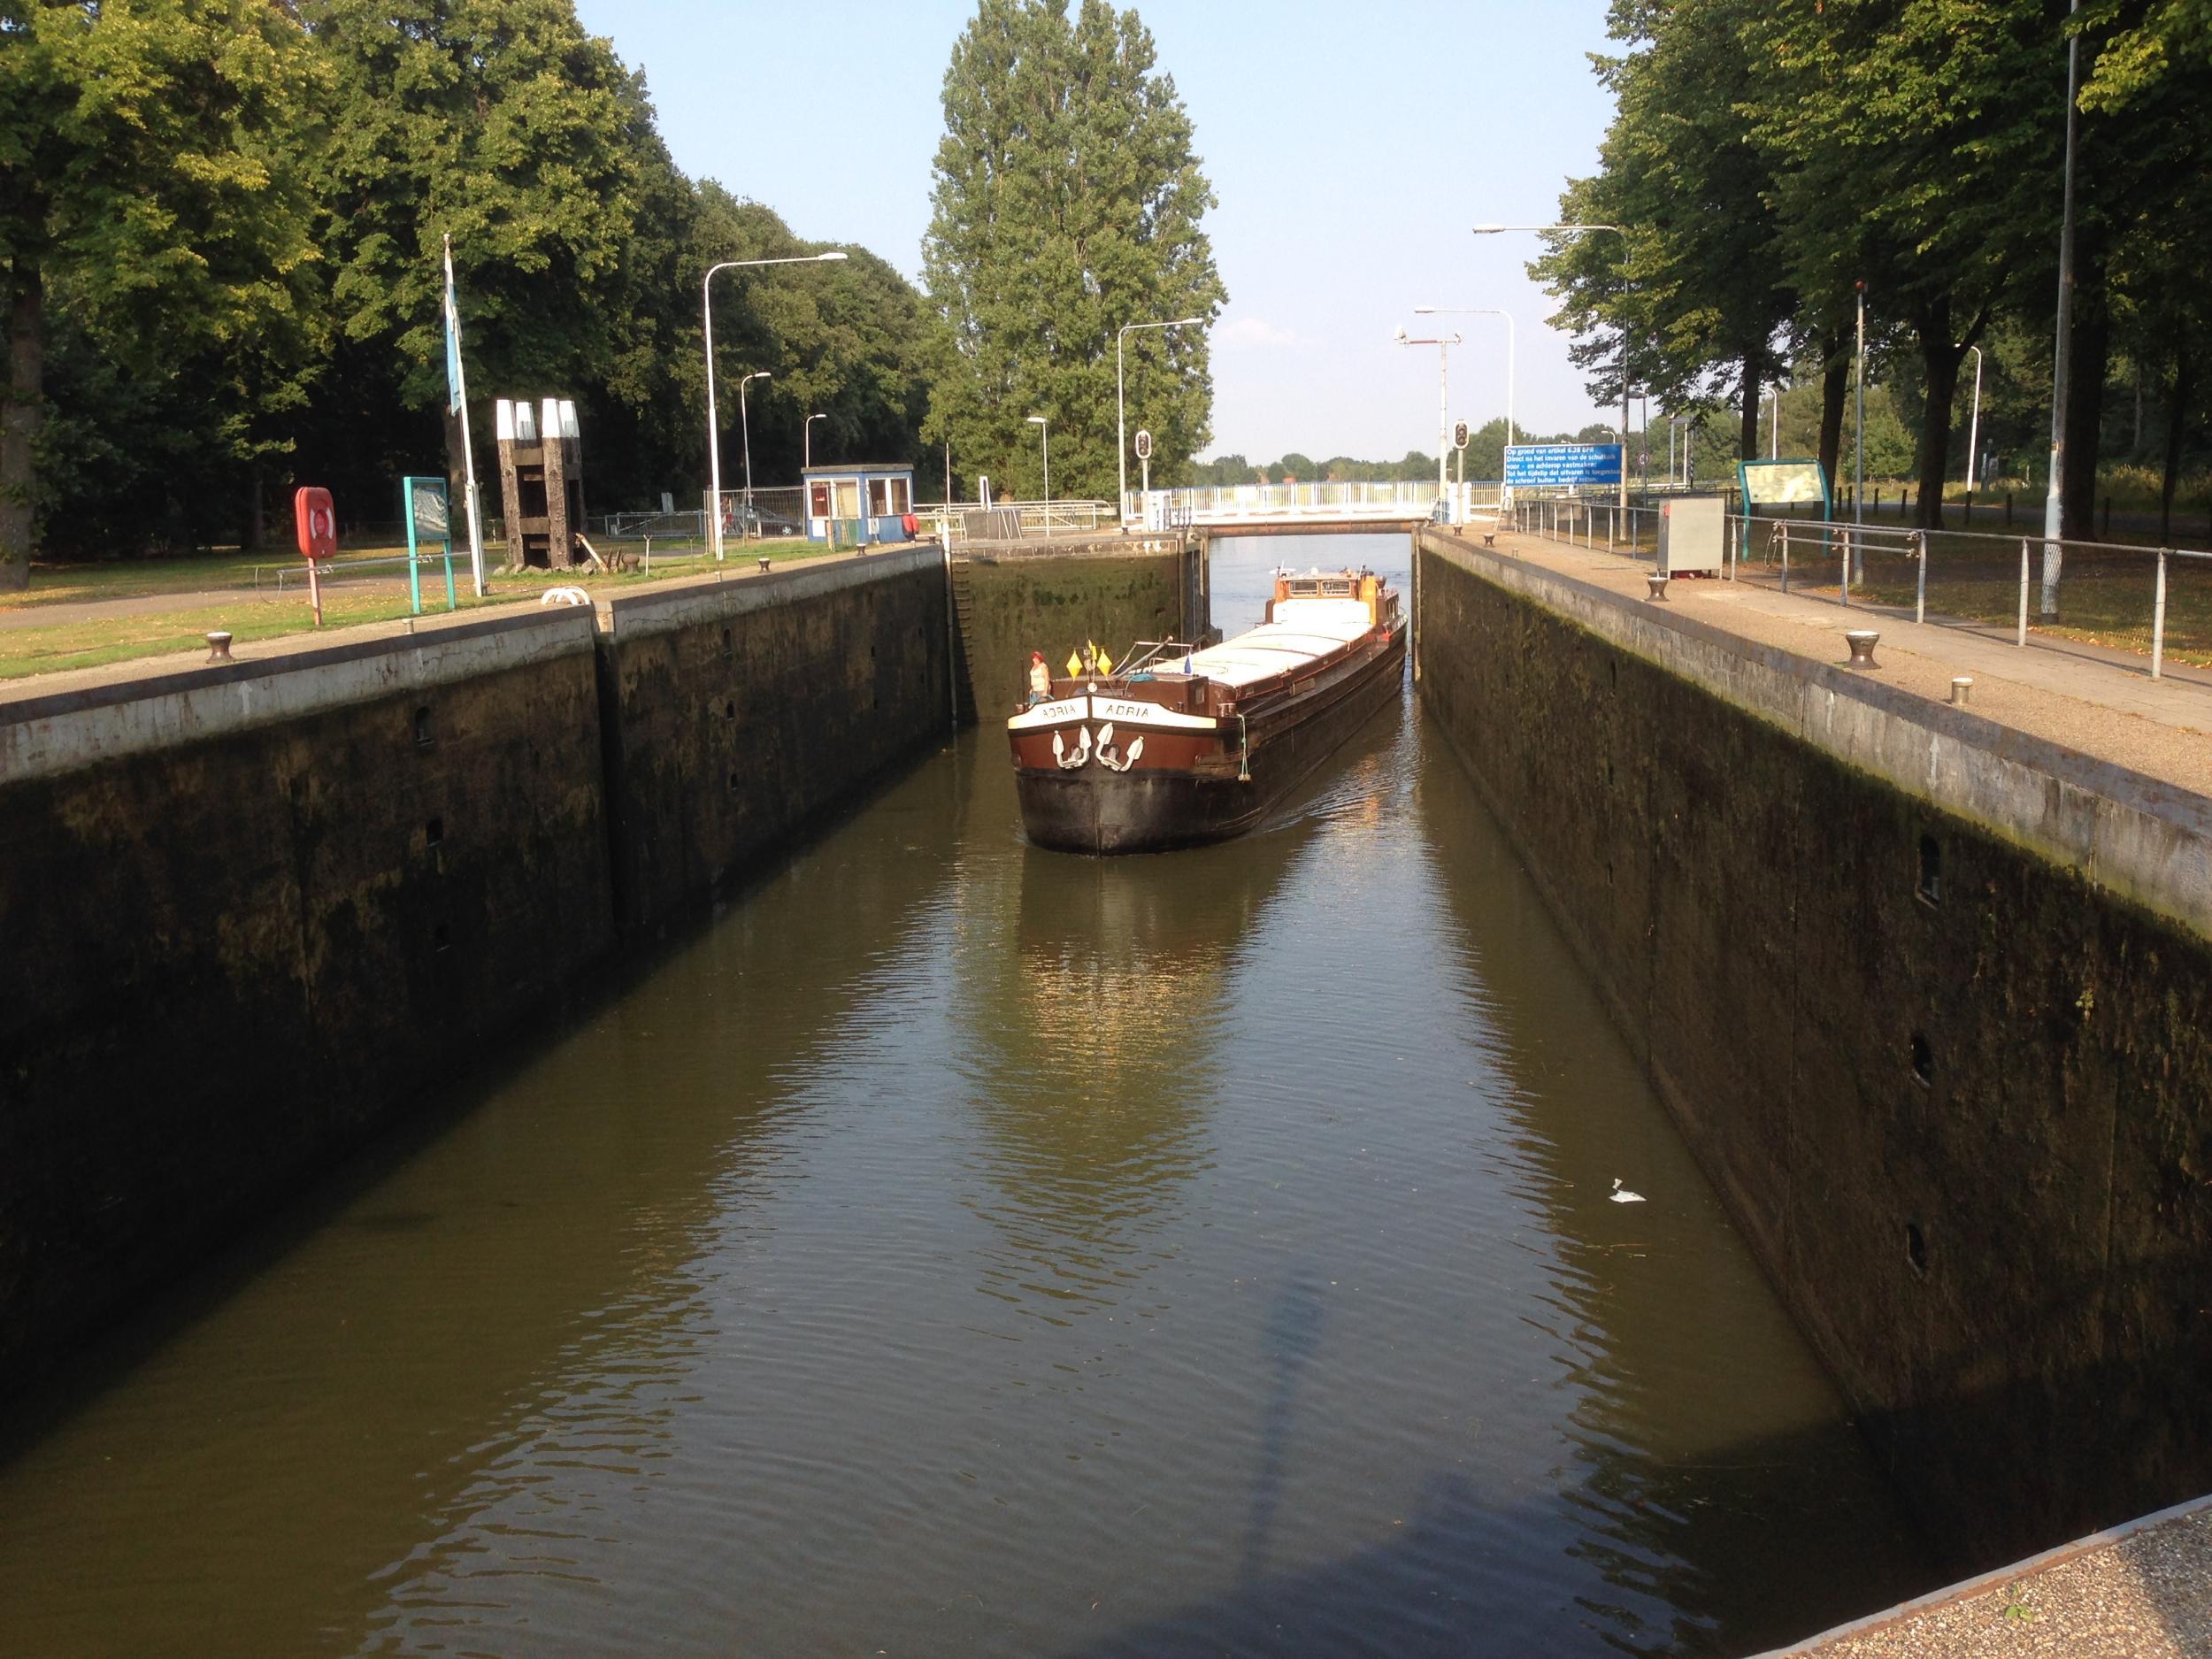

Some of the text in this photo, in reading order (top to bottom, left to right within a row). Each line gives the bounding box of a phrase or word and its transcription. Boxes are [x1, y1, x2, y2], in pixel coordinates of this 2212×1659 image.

[1558, 475, 1578, 484] bedrijf
[1042, 704, 1076, 718] ADRIA
[1105, 704, 1149, 718] ADRIA
